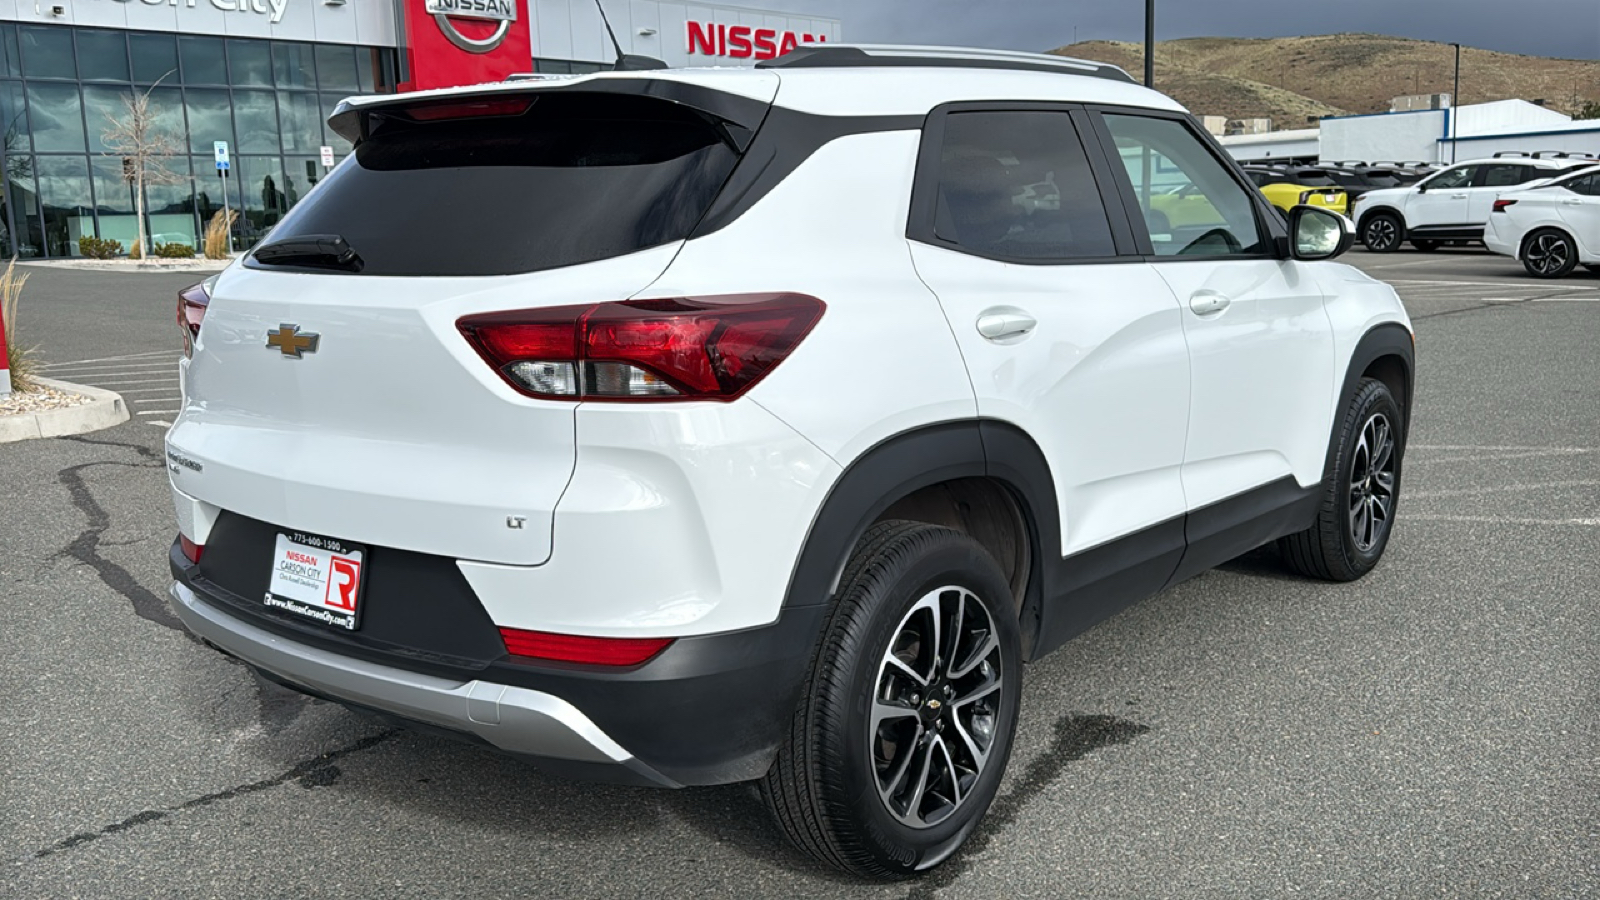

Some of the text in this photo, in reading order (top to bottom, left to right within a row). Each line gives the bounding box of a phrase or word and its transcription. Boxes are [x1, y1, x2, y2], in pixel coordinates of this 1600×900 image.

[683, 20, 826, 60] NISSA
[506, 515, 527, 529] LT
[286, 550, 318, 566] NISSAN
[280, 560, 321, 580] CARSON CITY
